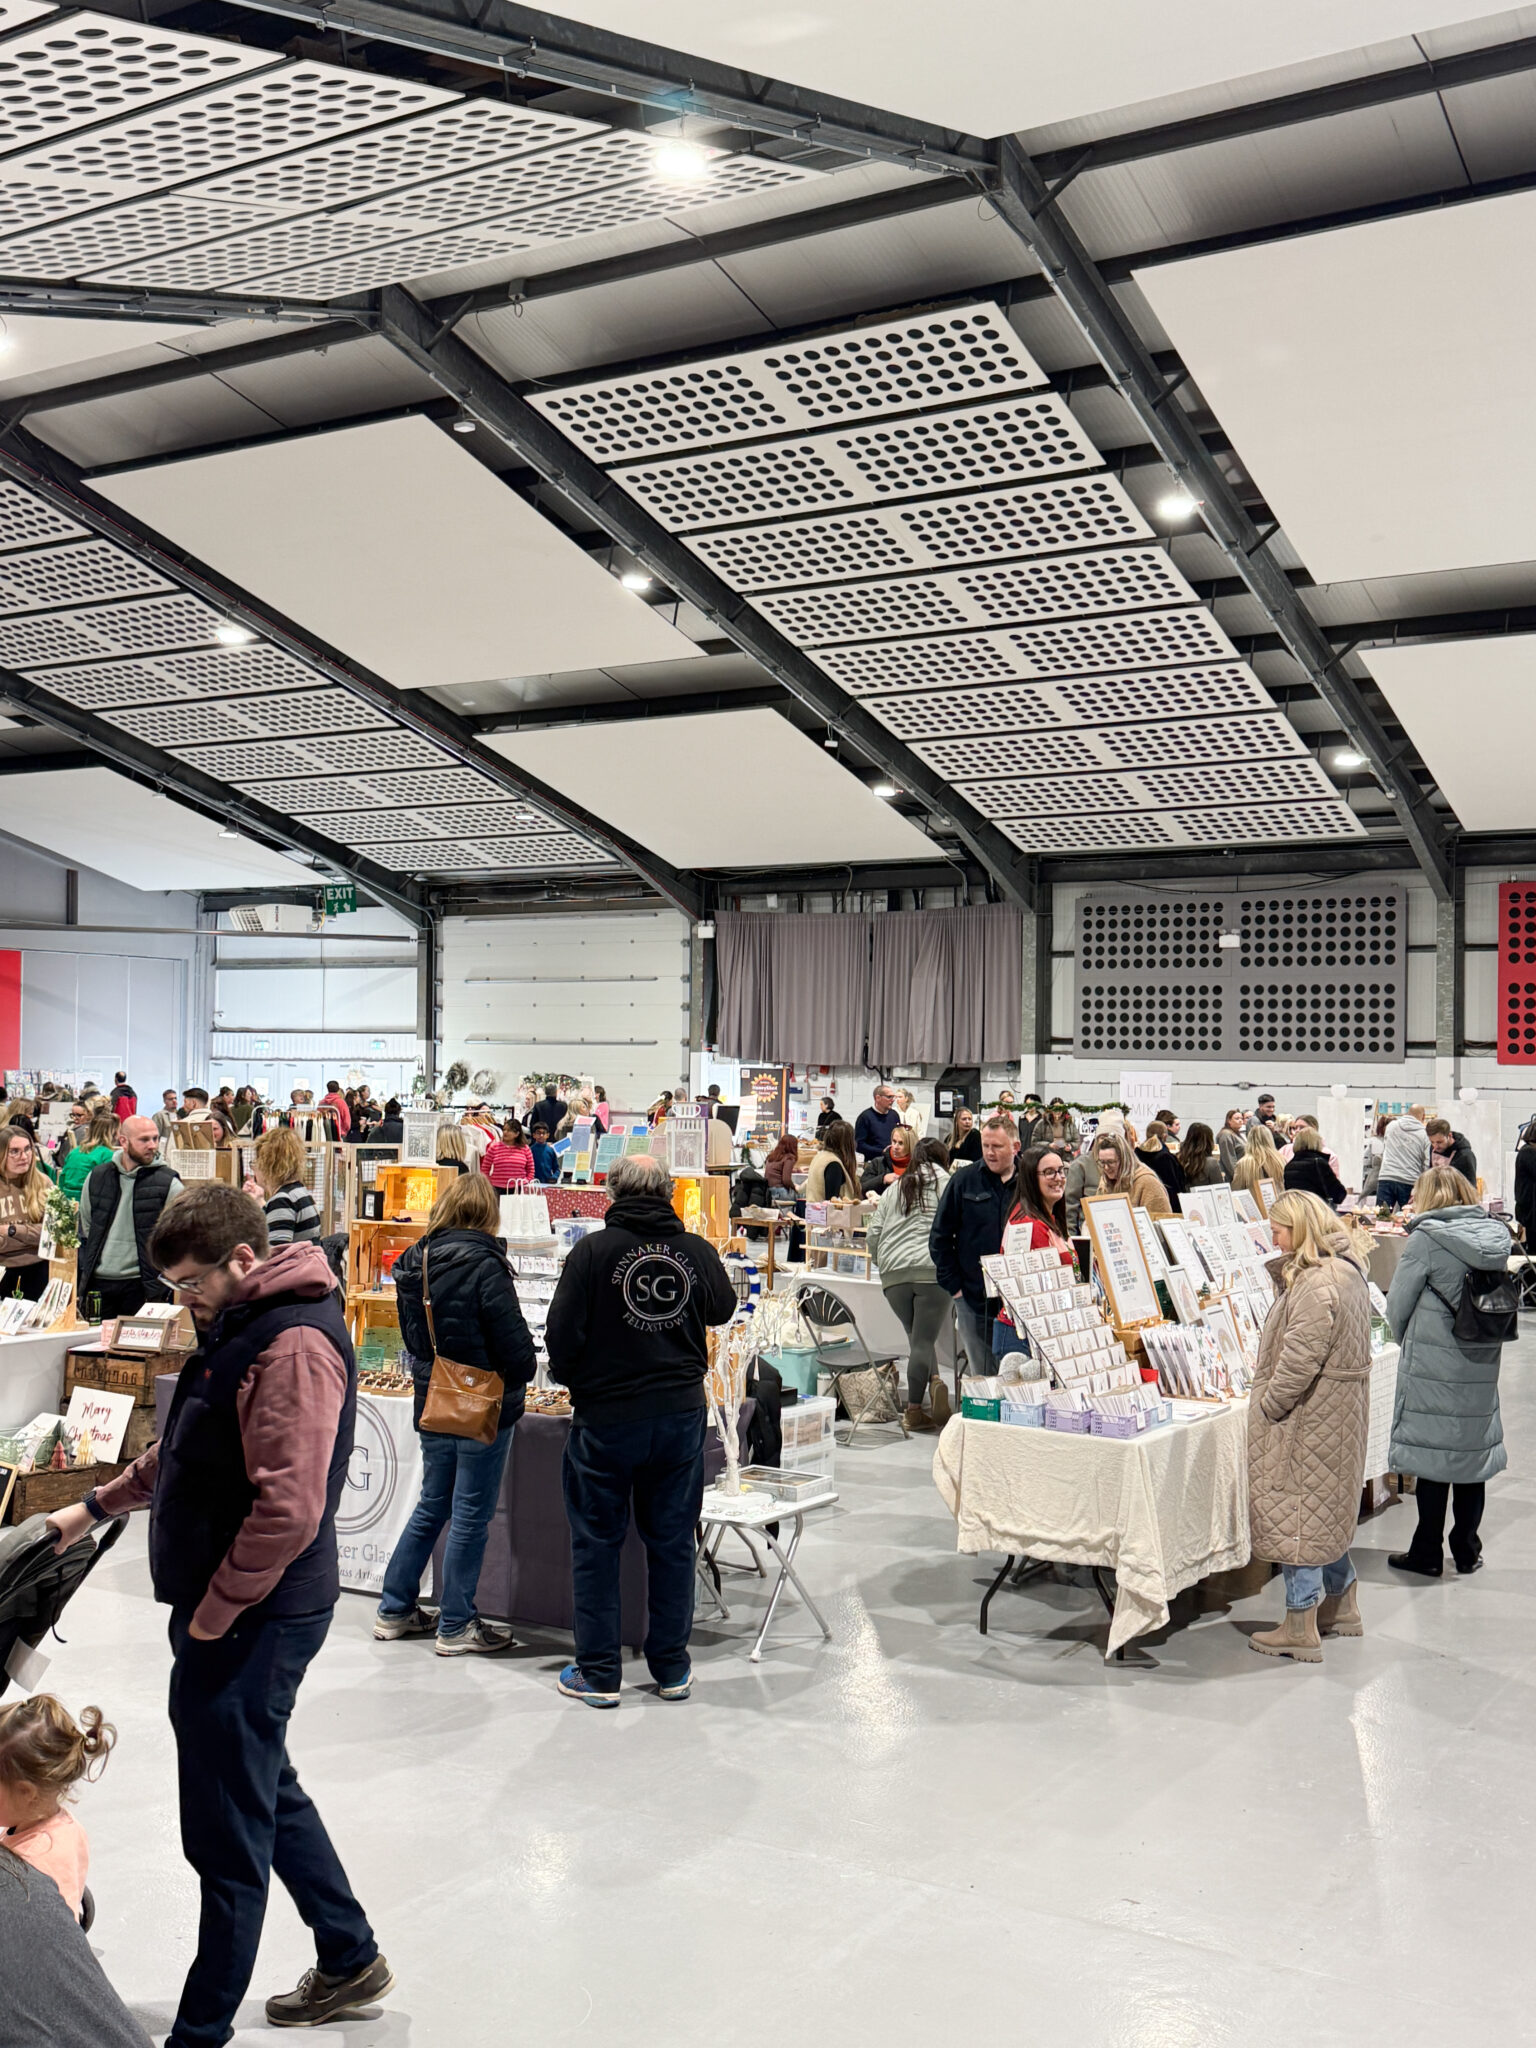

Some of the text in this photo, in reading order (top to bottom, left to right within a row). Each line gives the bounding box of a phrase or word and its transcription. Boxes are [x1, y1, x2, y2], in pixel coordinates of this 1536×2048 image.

[326, 886, 354, 900] EXIT
[1127, 1084, 1168, 1098] LITTLE
[611, 1243, 698, 1286] SPINNAKER GLASS
[636, 1275, 678, 1301] SG
[622, 1309, 690, 1332] FELIXSTOWE
